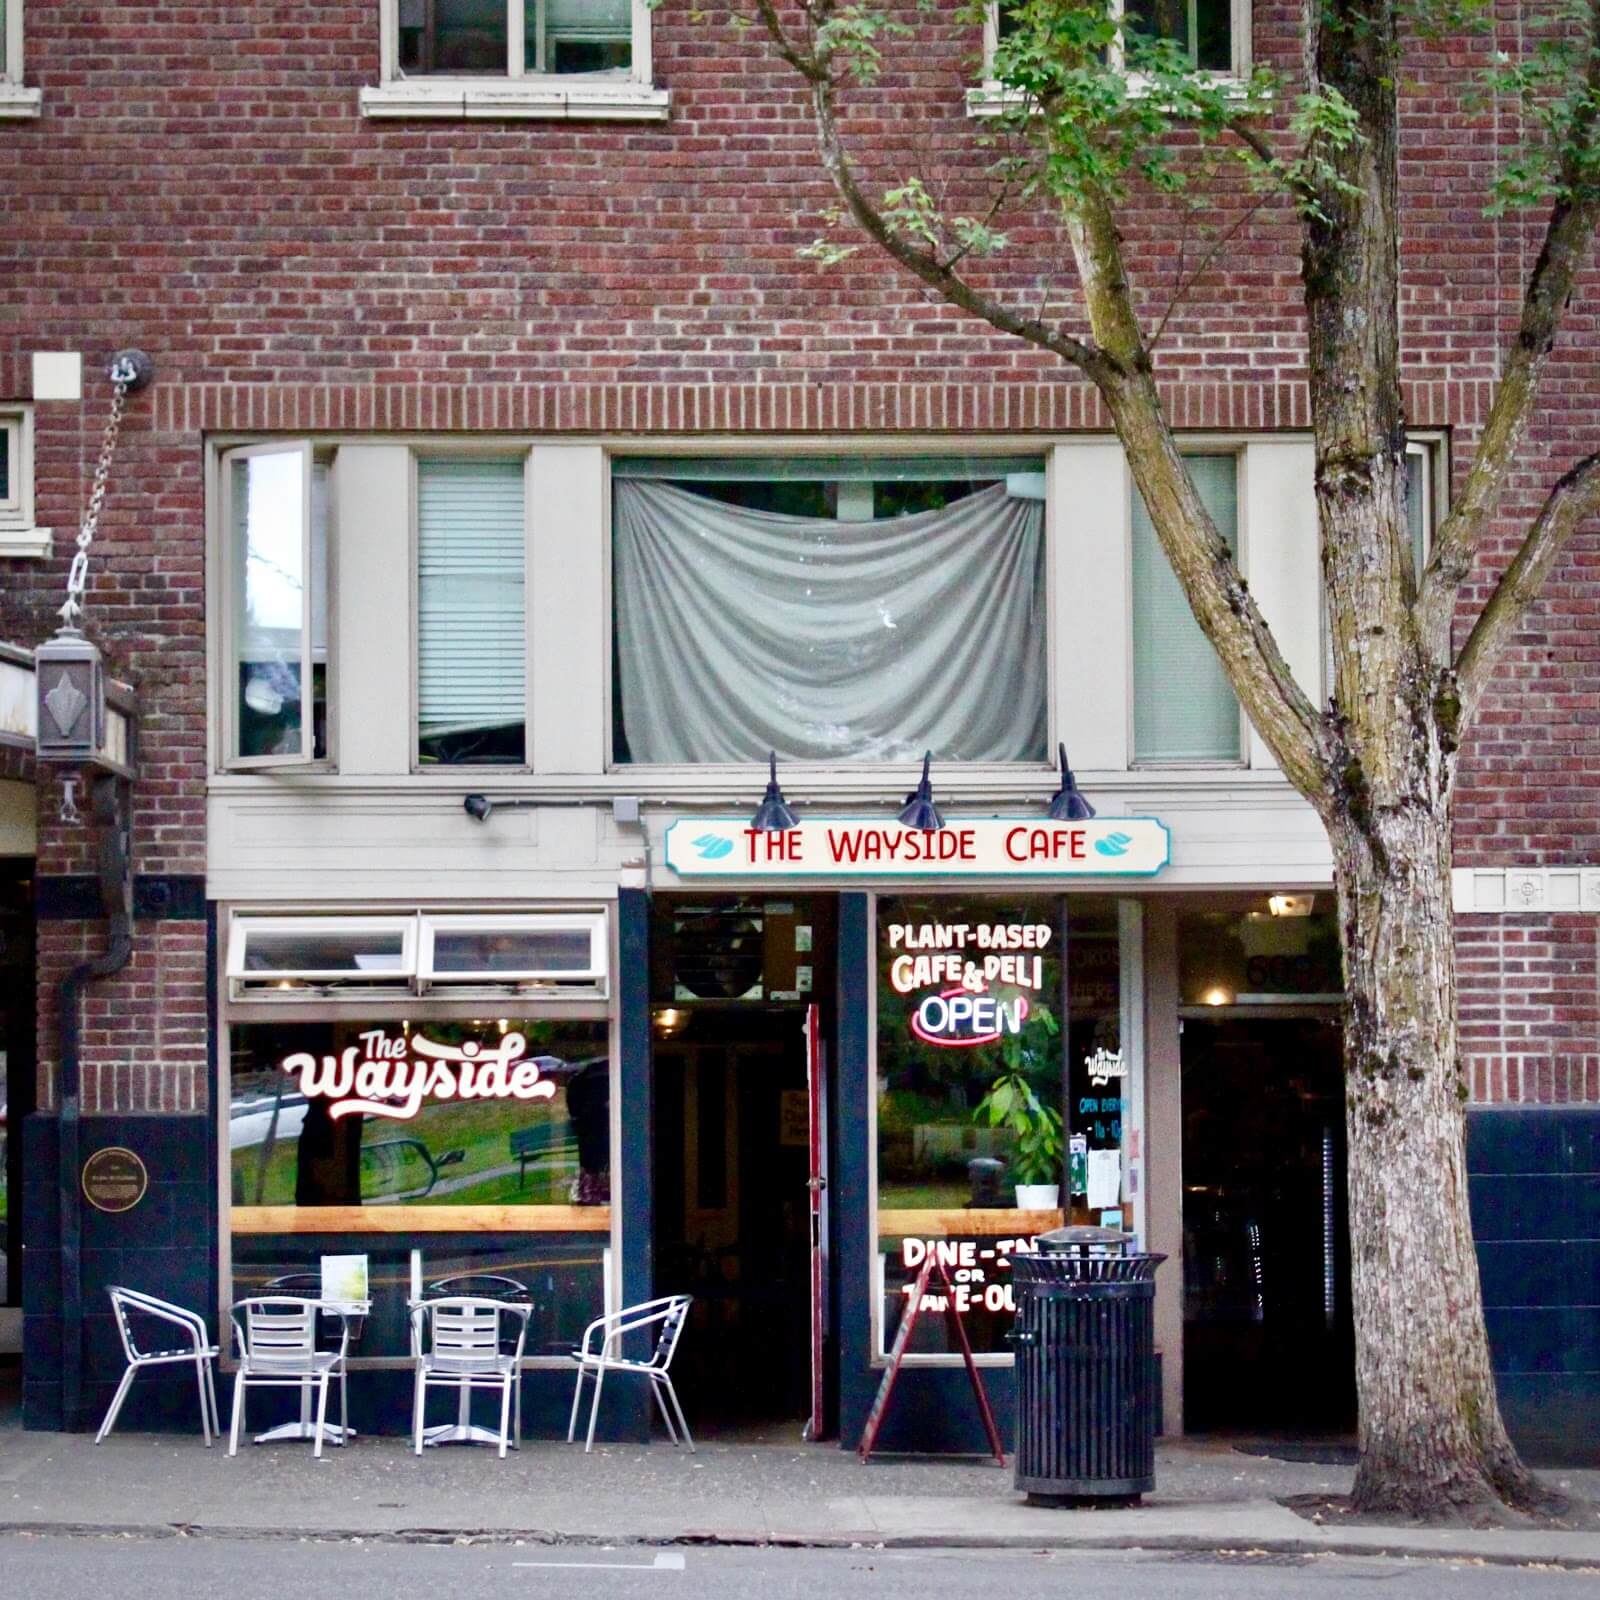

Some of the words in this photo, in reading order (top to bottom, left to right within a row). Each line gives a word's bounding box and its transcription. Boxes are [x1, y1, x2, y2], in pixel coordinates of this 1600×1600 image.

[743, 829, 802, 863] THE
[828, 829, 977, 863] WAYSIDE
[1005, 827, 1086, 863] CAFE
[888, 923, 1052, 950] PLANT-BASED
[919, 996, 1021, 1034] OPEN
[359, 1029, 408, 1059] The
[283, 1032, 557, 1120] Wayside
[1084, 1048, 1128, 1087] Wayside
[1079, 1097, 1099, 1114] OPEN
[902, 1237, 1040, 1268] DINE-IN
[954, 1268, 986, 1283] OR
